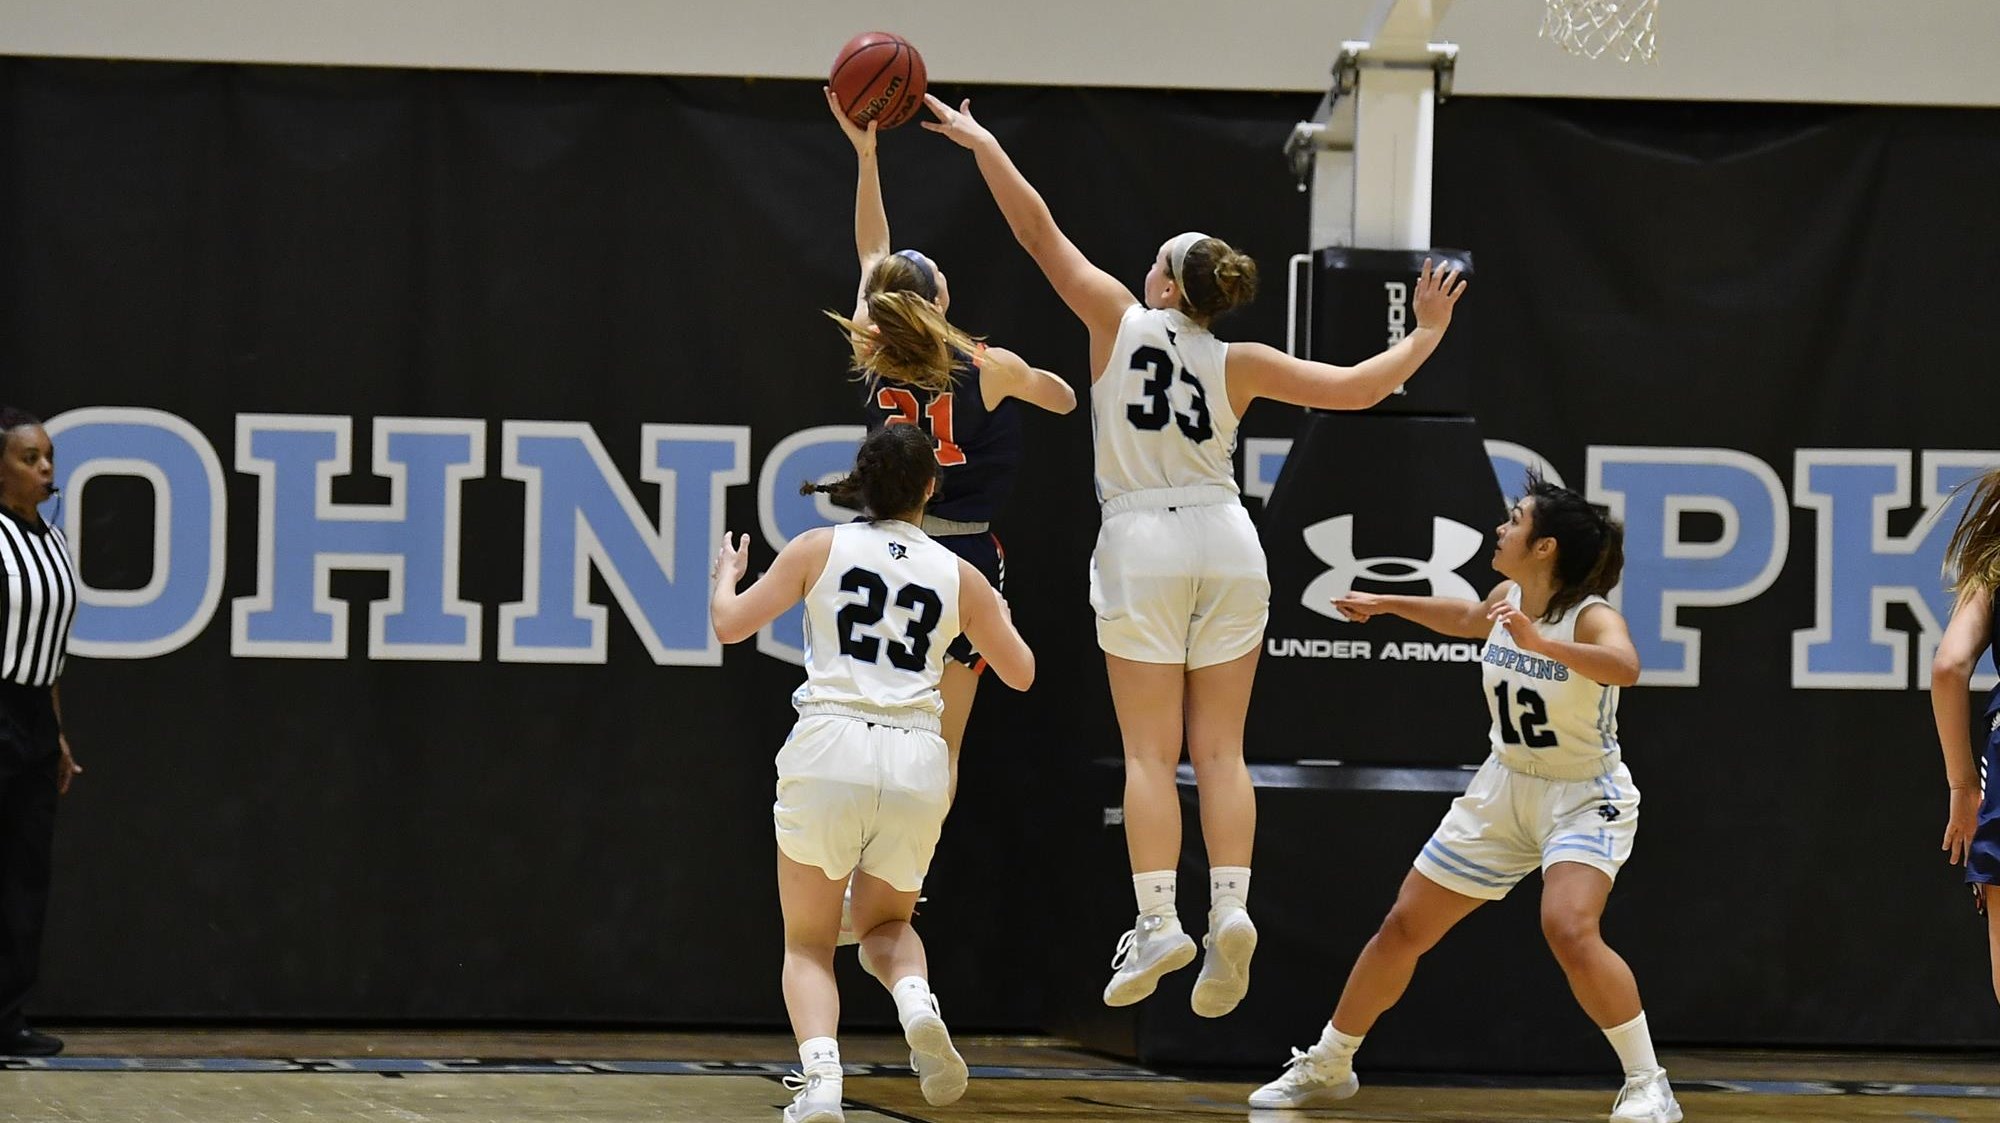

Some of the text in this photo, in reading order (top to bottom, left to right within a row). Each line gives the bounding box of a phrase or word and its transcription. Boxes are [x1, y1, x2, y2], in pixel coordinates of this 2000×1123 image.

[1126, 344, 1213, 444] 33
[836, 567, 943, 673] 23
[1267, 638, 1485, 663] UNDER ARMOU
[1484, 643, 1569, 682] HOPKINS
[1494, 680, 1559, 748] 12
